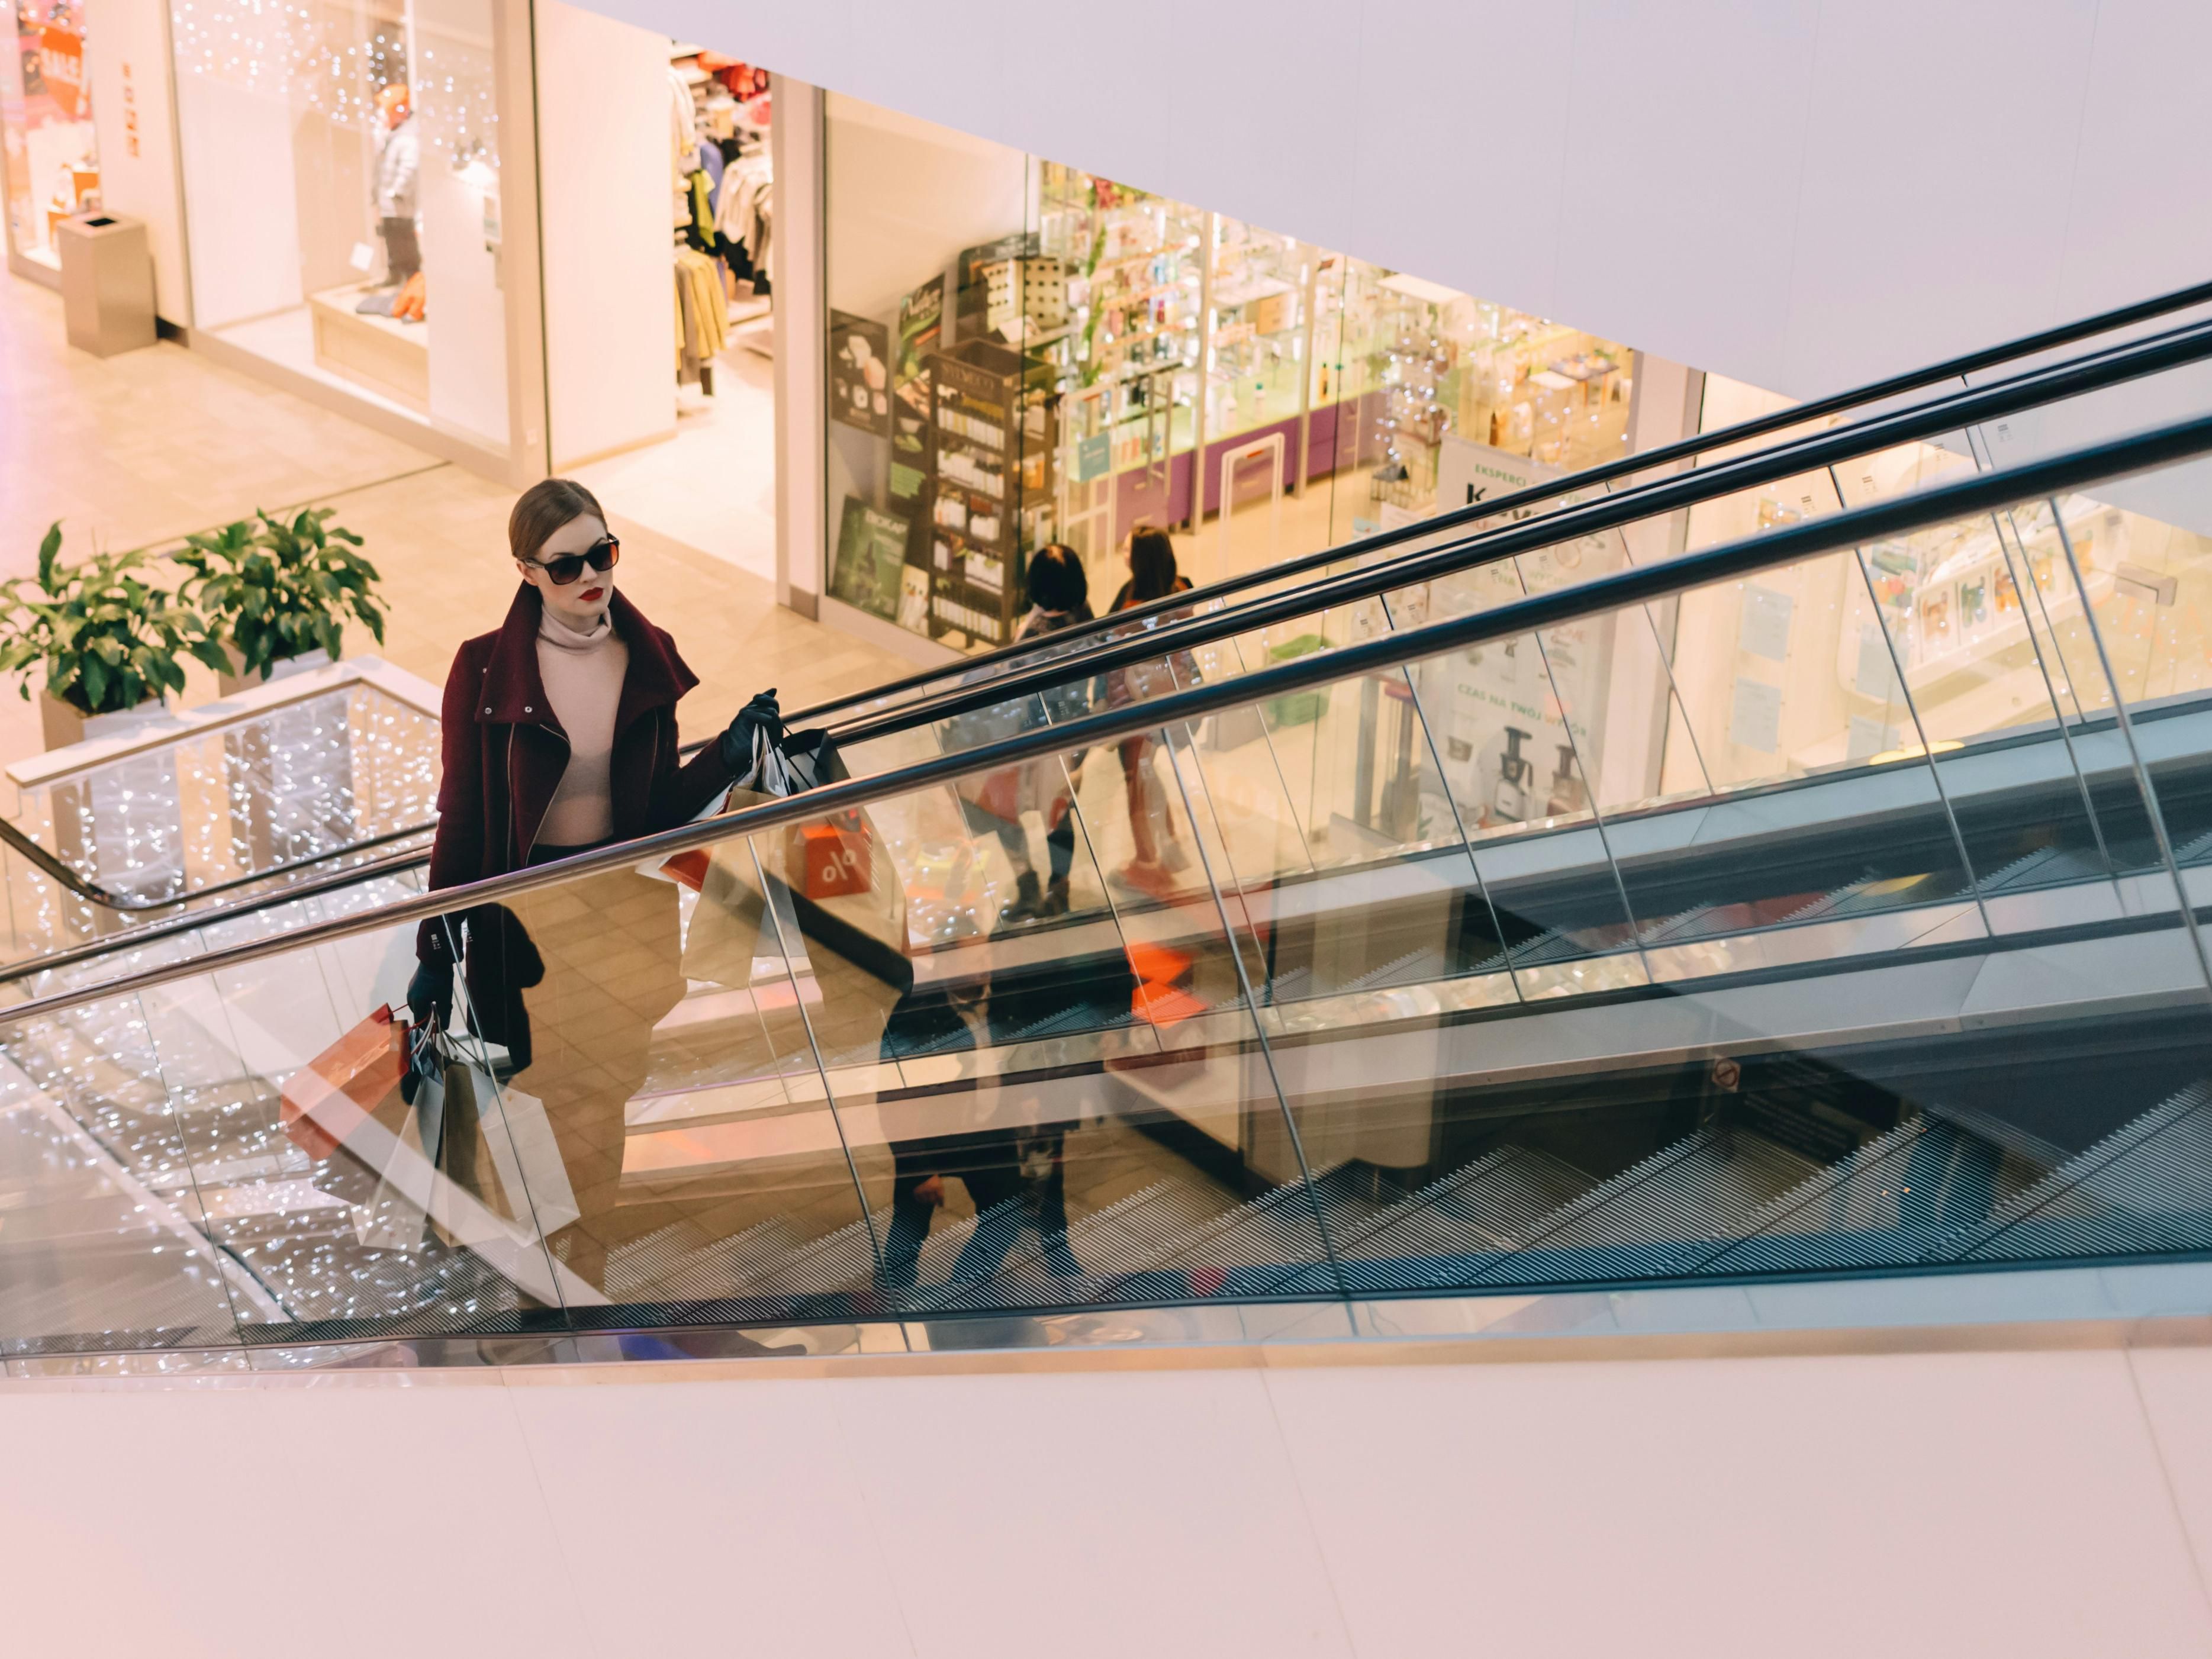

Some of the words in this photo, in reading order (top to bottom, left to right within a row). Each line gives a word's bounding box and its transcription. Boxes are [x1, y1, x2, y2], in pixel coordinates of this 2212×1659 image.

[1475, 463, 1527, 487] EKSPERCI
[1457, 683, 1486, 701] CZAS
[1489, 694, 1506, 707] NA
[1545, 714, 1587, 736] WYÓR
